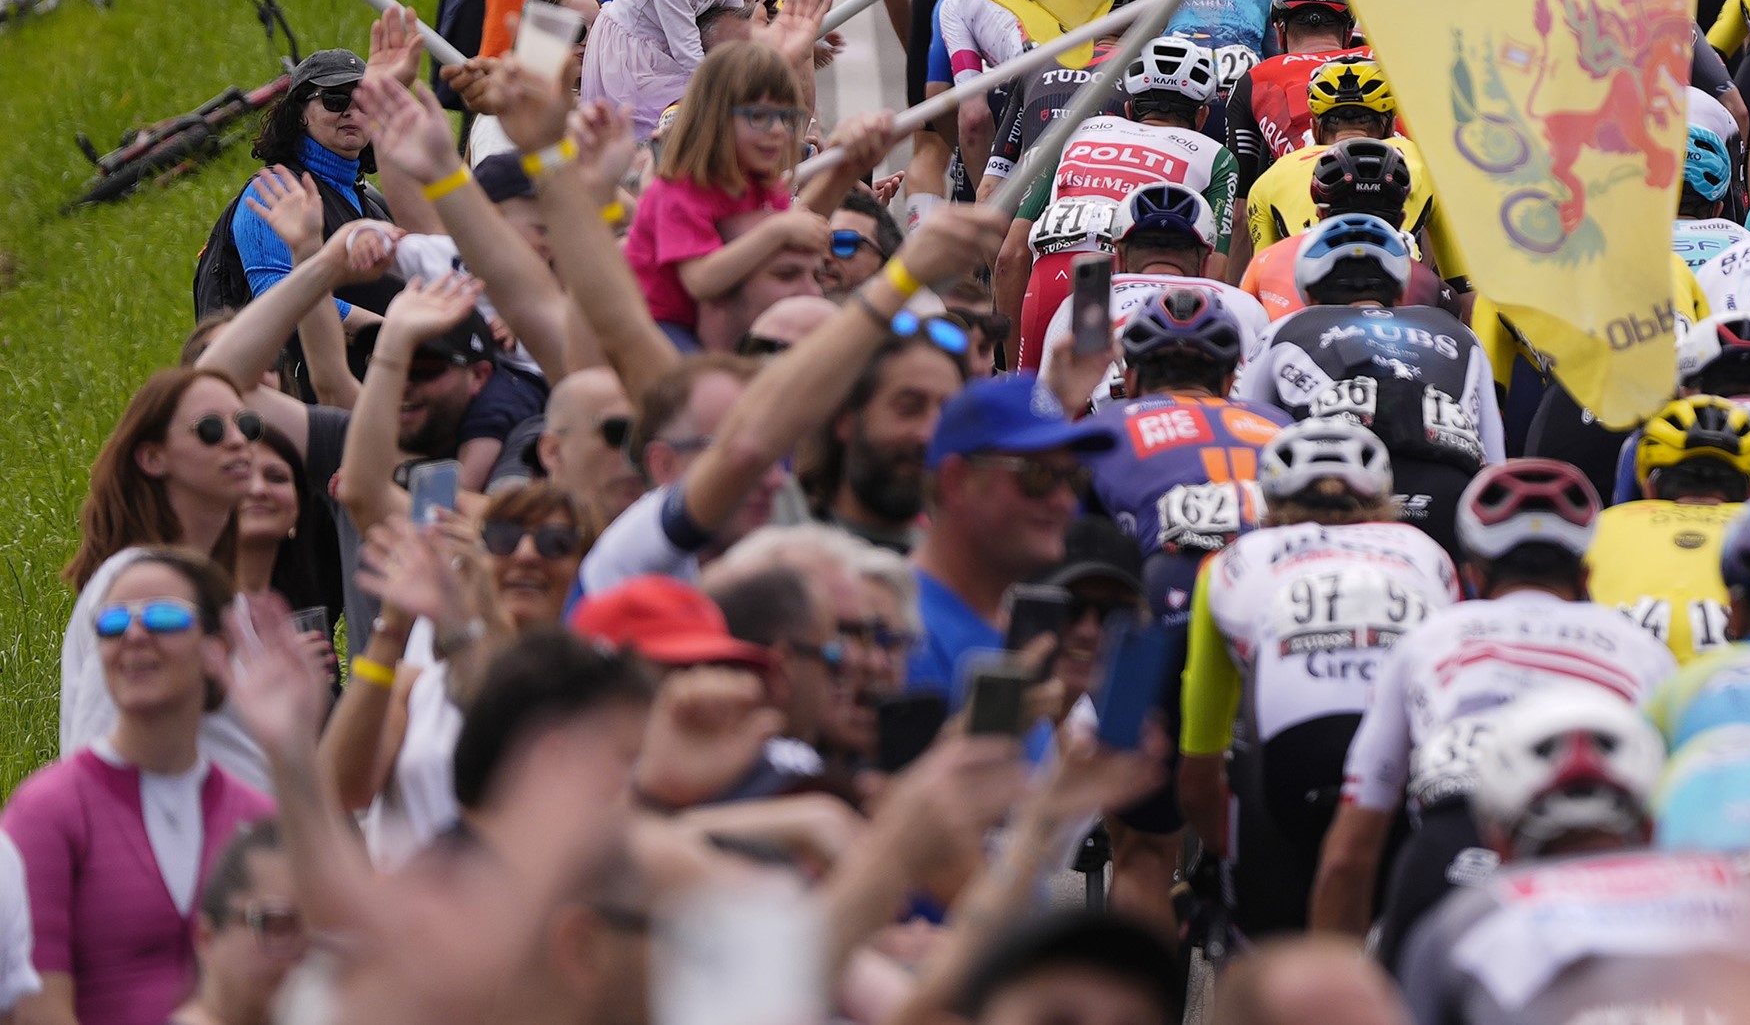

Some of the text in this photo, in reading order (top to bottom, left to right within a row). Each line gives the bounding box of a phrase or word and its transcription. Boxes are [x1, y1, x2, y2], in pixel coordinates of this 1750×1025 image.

[1153, 76, 1178, 86] KASK
[1068, 145, 1176, 176] POLTI
[1058, 172, 1141, 197] VisitMa
[1220, 172, 1239, 235] KOMETA
[1289, 574, 1342, 623] 97
